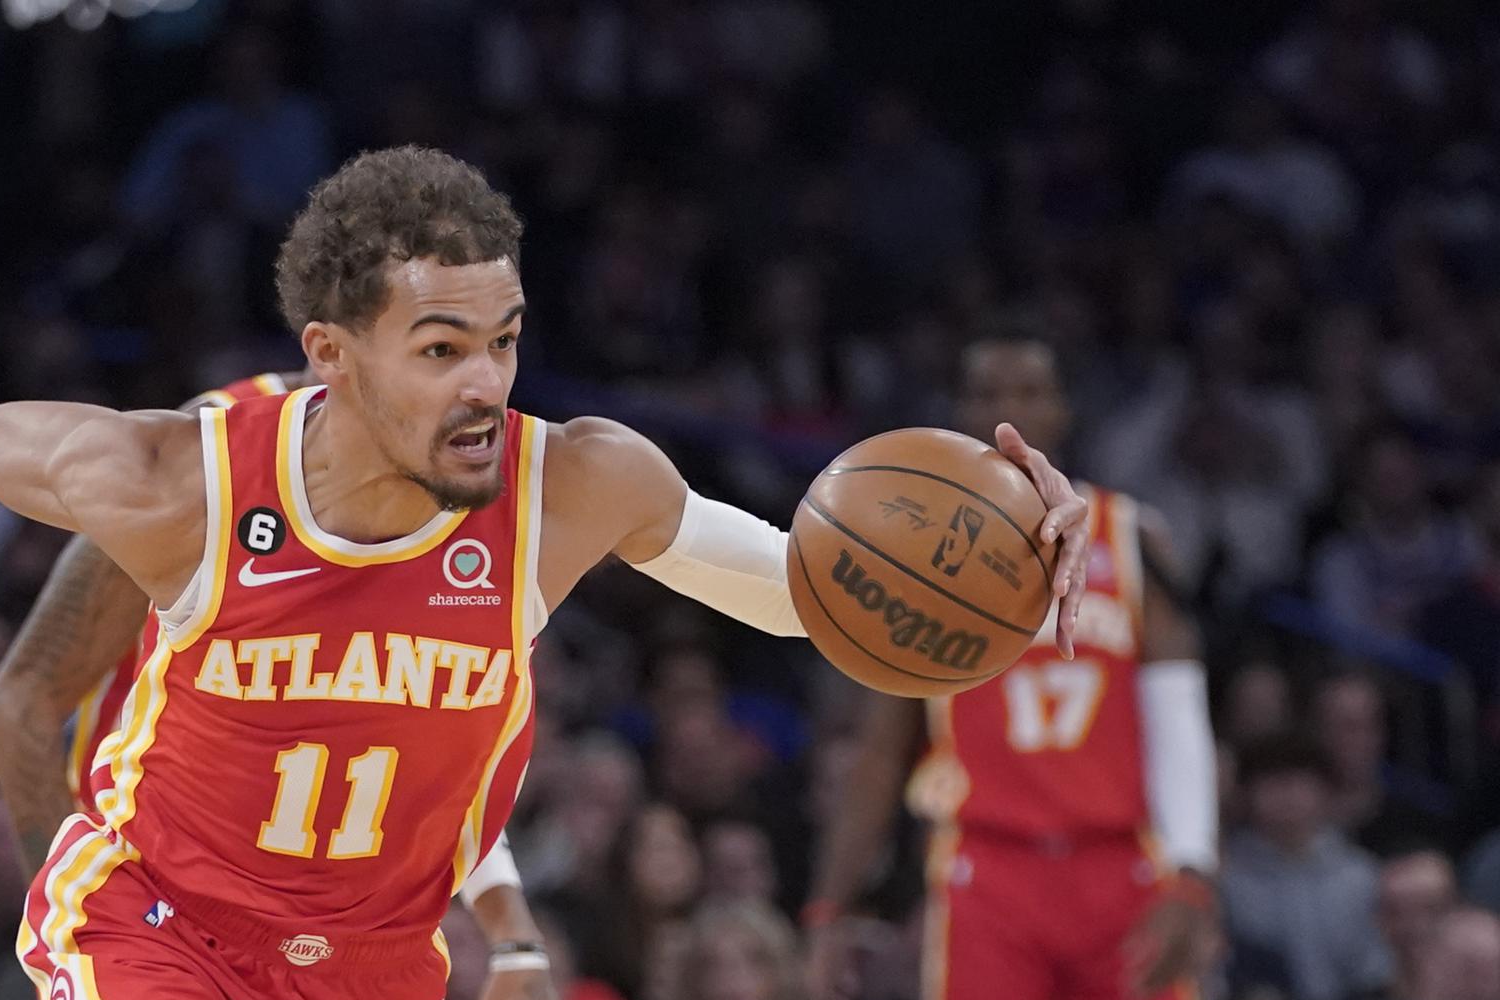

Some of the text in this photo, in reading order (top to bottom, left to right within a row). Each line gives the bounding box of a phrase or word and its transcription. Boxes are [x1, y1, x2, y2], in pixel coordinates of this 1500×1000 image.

[247, 512, 277, 552] 6
[428, 592, 501, 607] sharecare
[830, 549, 989, 671] Wilson
[194, 631, 513, 711] ATLANTA
[1003, 659, 1106, 754] 17
[256, 741, 400, 861] 11
[279, 938, 334, 960] HAWKS
